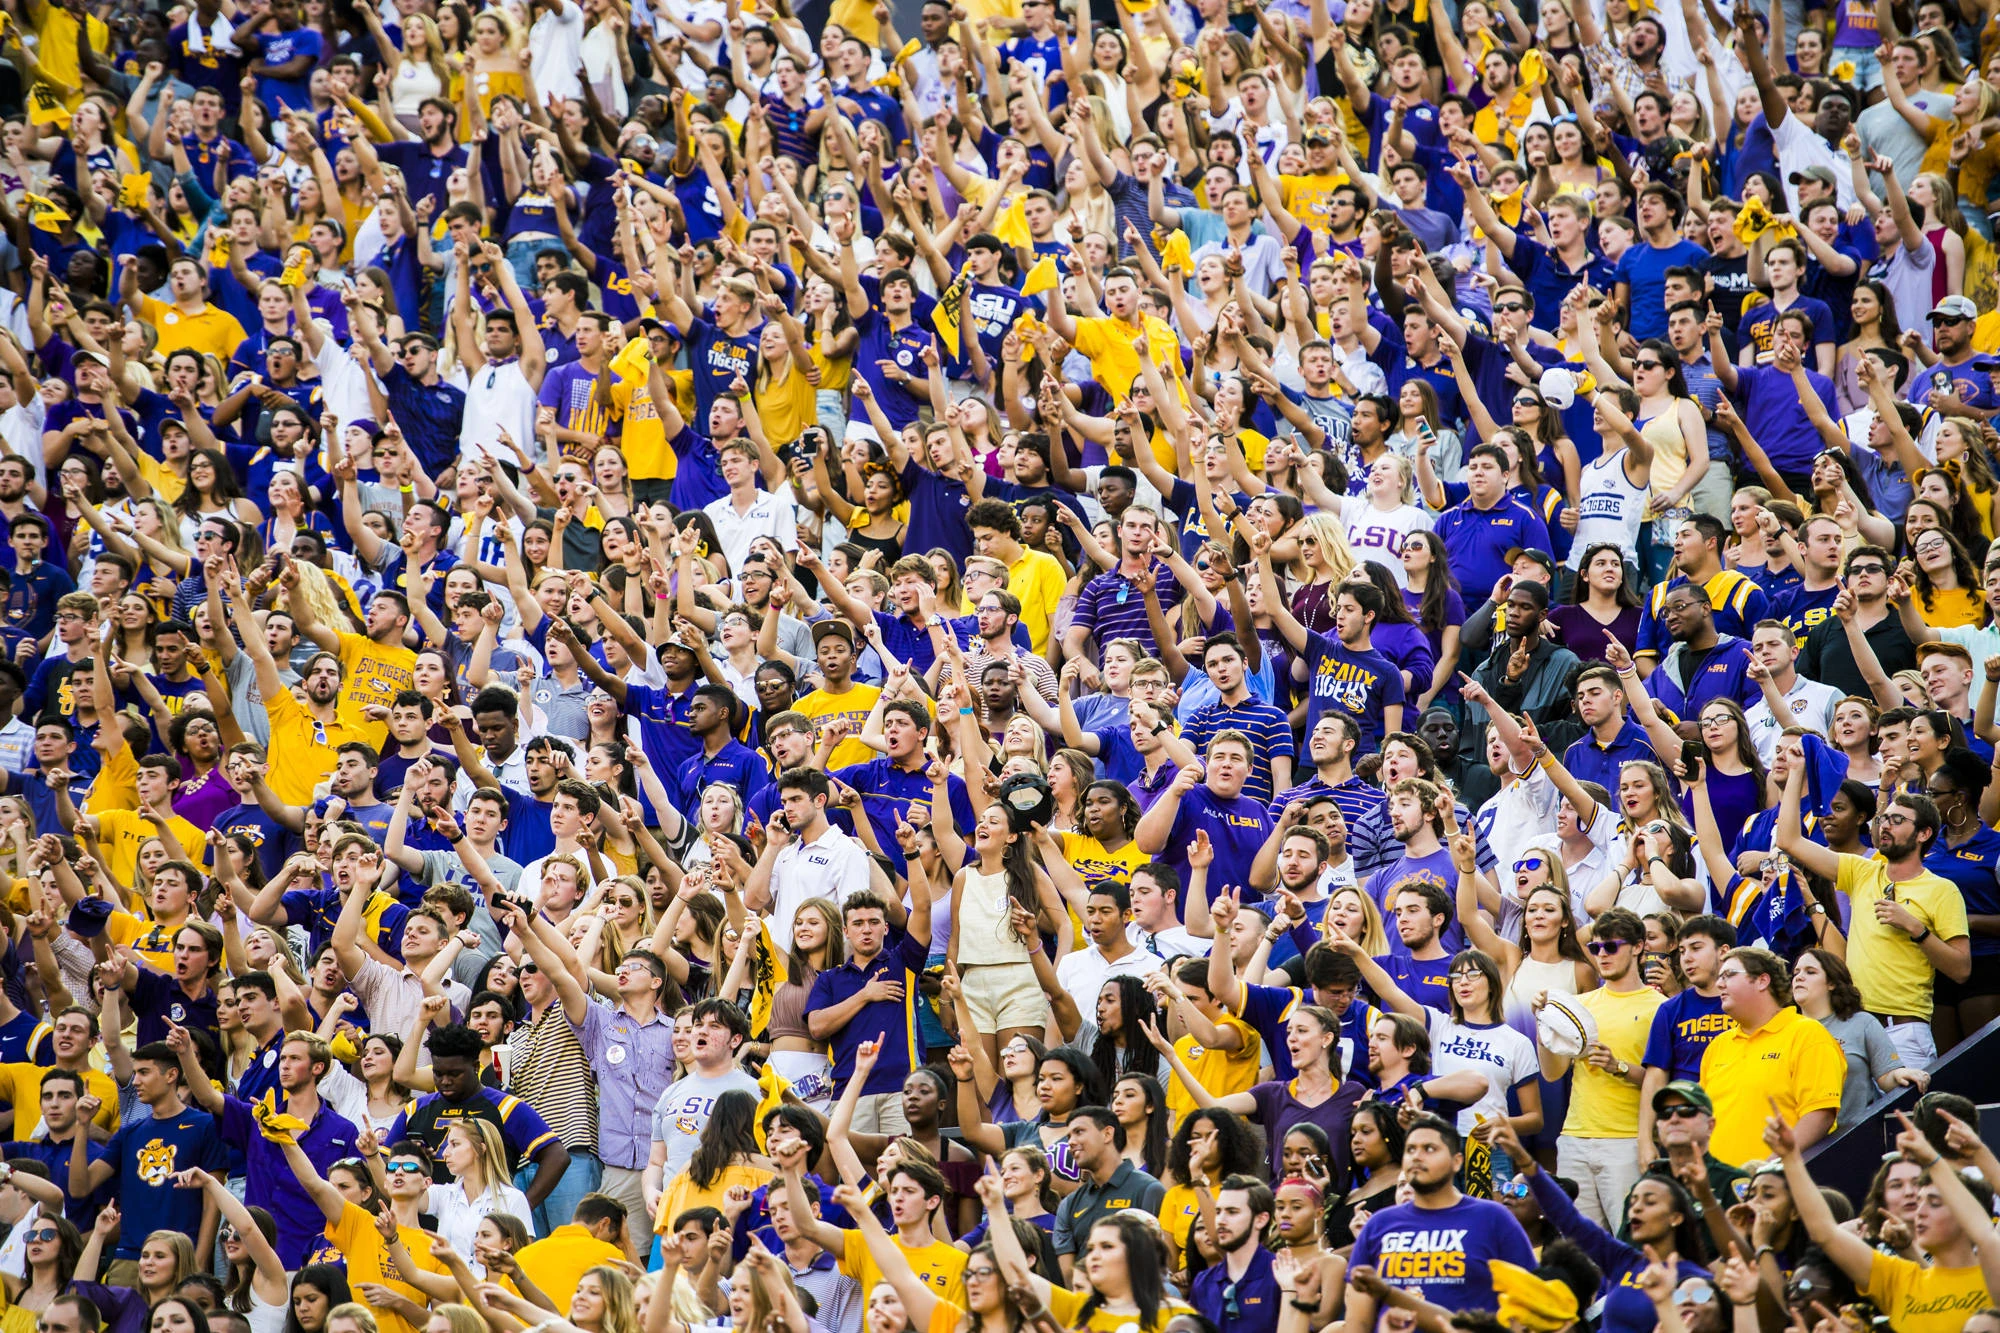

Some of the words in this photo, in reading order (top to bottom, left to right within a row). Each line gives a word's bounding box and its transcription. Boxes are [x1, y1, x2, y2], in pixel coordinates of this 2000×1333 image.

[706, 350, 750, 378] TIGERS
[1435, 367, 1455, 378] LSU
[1491, 518, 1513, 527] LSU
[377, 659, 411, 689] TIGERS
[1317, 654, 1377, 686] GEAUX
[349, 690, 394, 711] ATHLETI
[808, 855, 830, 866] LSU
[1955, 850, 1983, 862] LSU
[1676, 1013, 1740, 1037] TIGER
[1439, 1041, 1505, 1068] TIGERS
[1453, 1034, 1489, 1053] LSU
[1105, 1199, 1131, 1209] LSU
[1381, 1229, 1467, 1252] GEAUX
[1378, 1251, 1466, 1279] TIGERS
